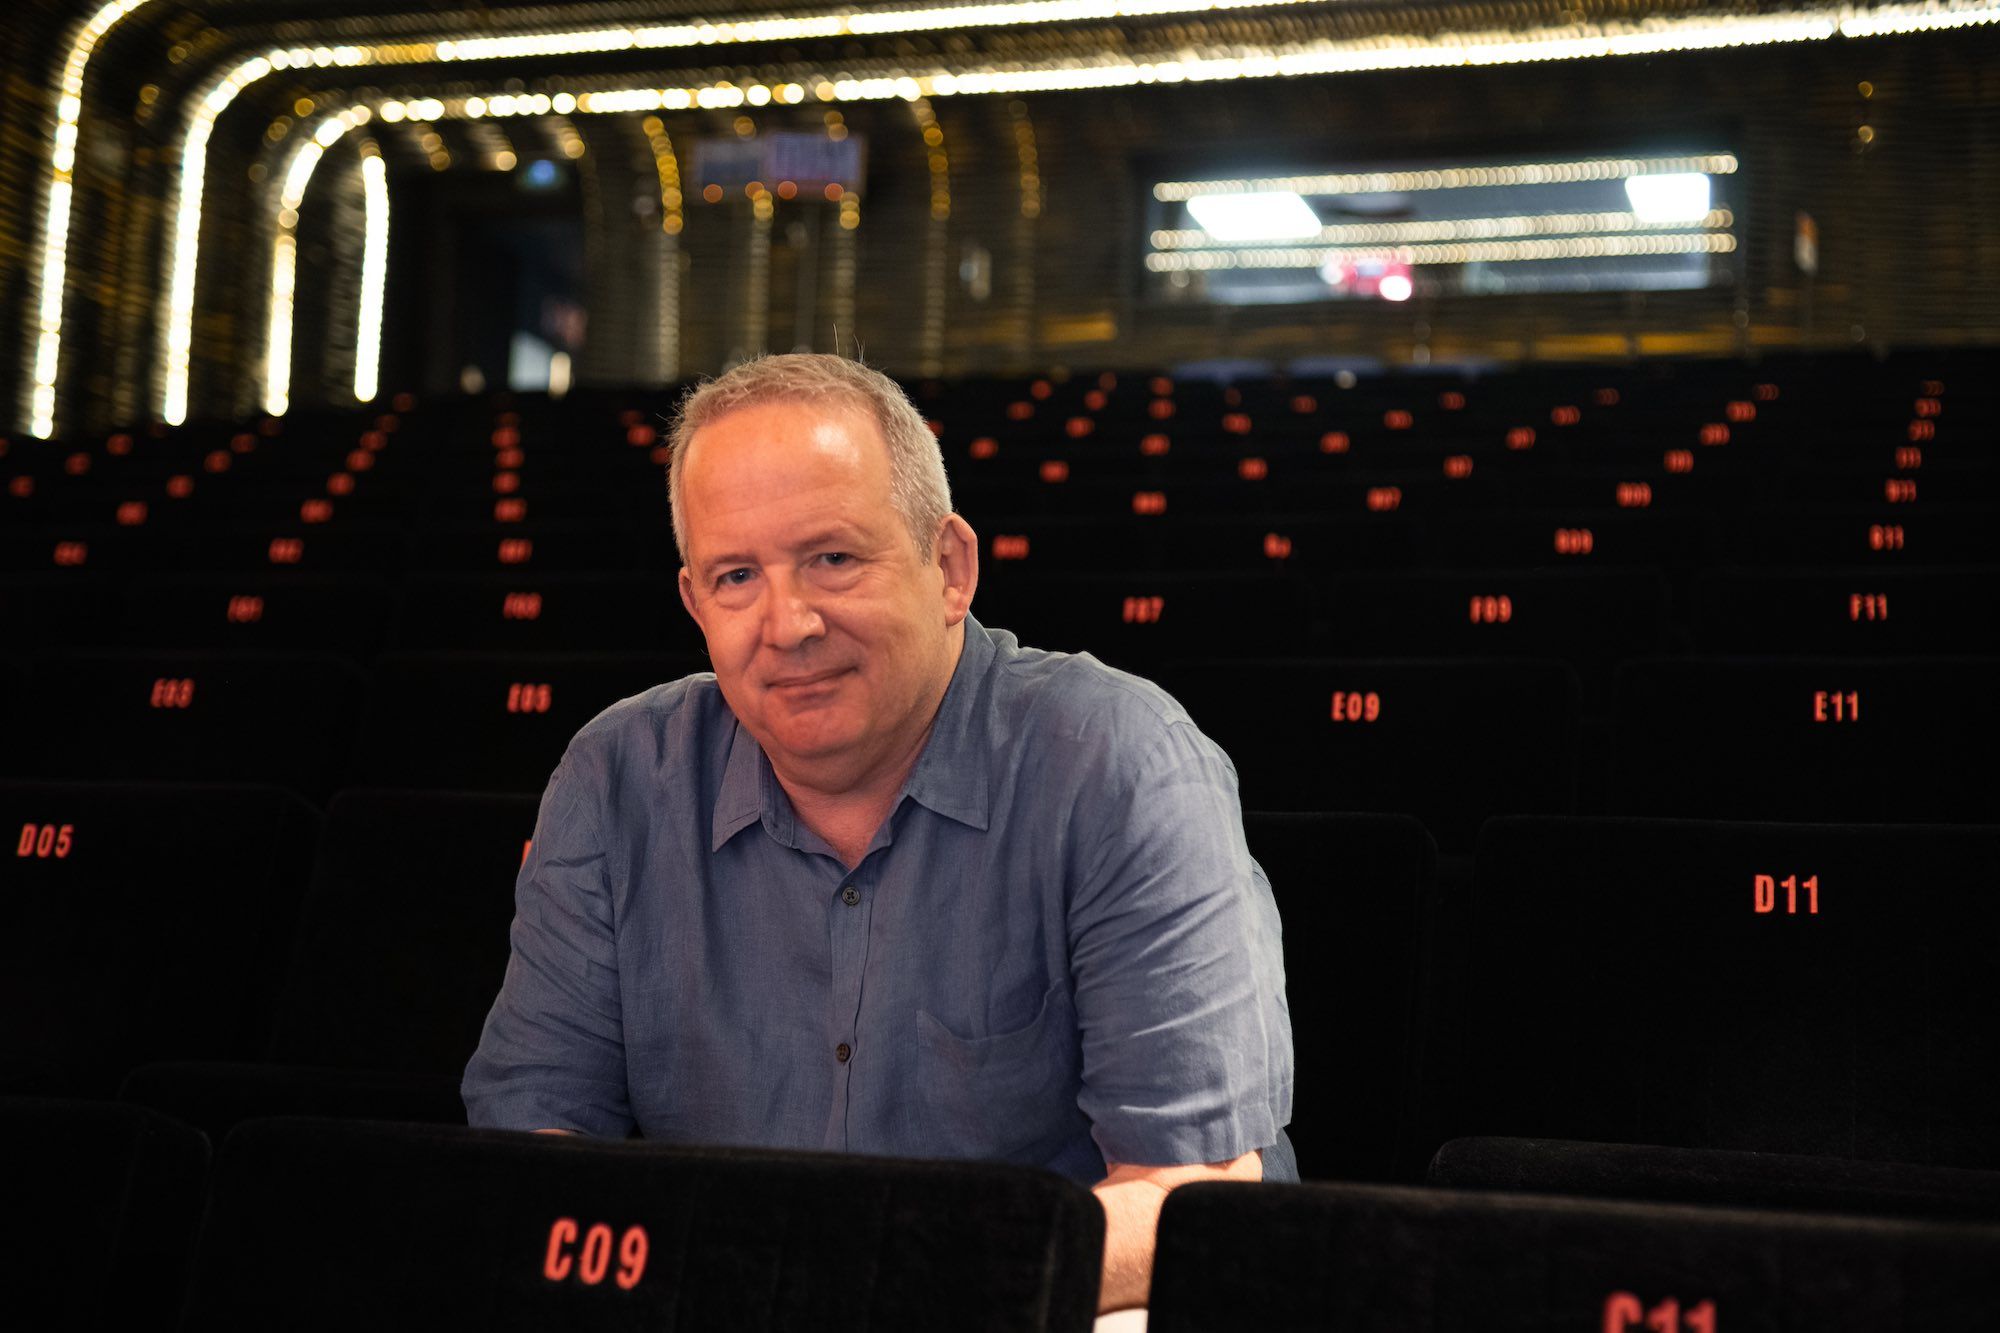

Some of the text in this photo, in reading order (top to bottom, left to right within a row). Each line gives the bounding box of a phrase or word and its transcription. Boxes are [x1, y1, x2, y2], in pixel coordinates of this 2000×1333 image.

[1331, 691, 1380, 722] E09
[1813, 691, 1859, 722] E11
[17, 823, 74, 858] D05
[1754, 874, 1819, 915] D11
[544, 1218, 649, 1290] C09
